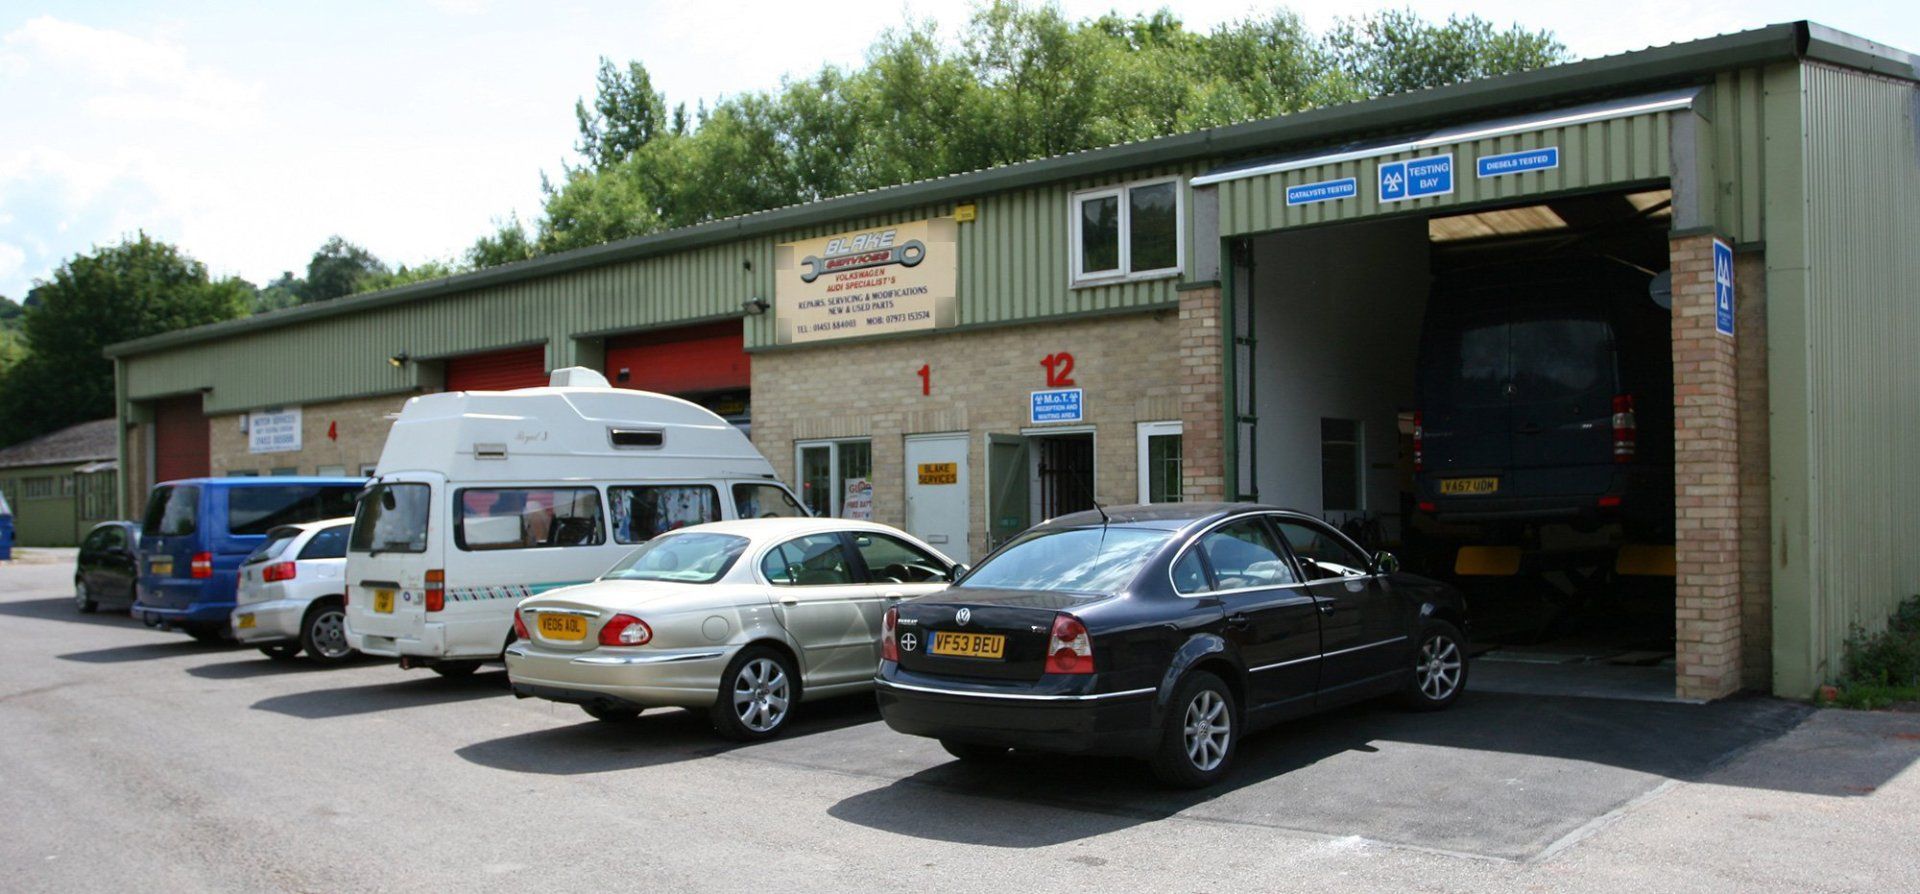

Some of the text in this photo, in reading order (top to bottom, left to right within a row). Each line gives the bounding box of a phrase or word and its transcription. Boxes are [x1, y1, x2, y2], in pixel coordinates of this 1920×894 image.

[1486, 153, 1548, 170] DIESELS TESTED
[1409, 163, 1449, 178] TESTING
[1289, 183, 1353, 200] CATALYSTS TESTED
[1419, 177, 1439, 189] BAY
[825, 229, 896, 254] BLAKE
[826, 251, 890, 269] SERVICES
[835, 268, 885, 282] VOLKSWAGEN
[827, 276, 896, 292] AUDI SPECIALIST'S
[827, 294, 863, 305] SERVICING
[872, 285, 928, 300] MODIFICATIONS
[828, 306, 843, 314] NEW
[852, 302, 870, 312] USED
[872, 300, 894, 310] PARTS
[1040, 352, 1075, 387] 12
[917, 364, 931, 396] 1
[1035, 404, 1066, 412] RECEPTION
[327, 420, 337, 442] 4
[924, 463, 950, 473] BLAKE
[918, 474, 957, 485] SERVICES
[935, 634, 1001, 654] VF53 BEU
